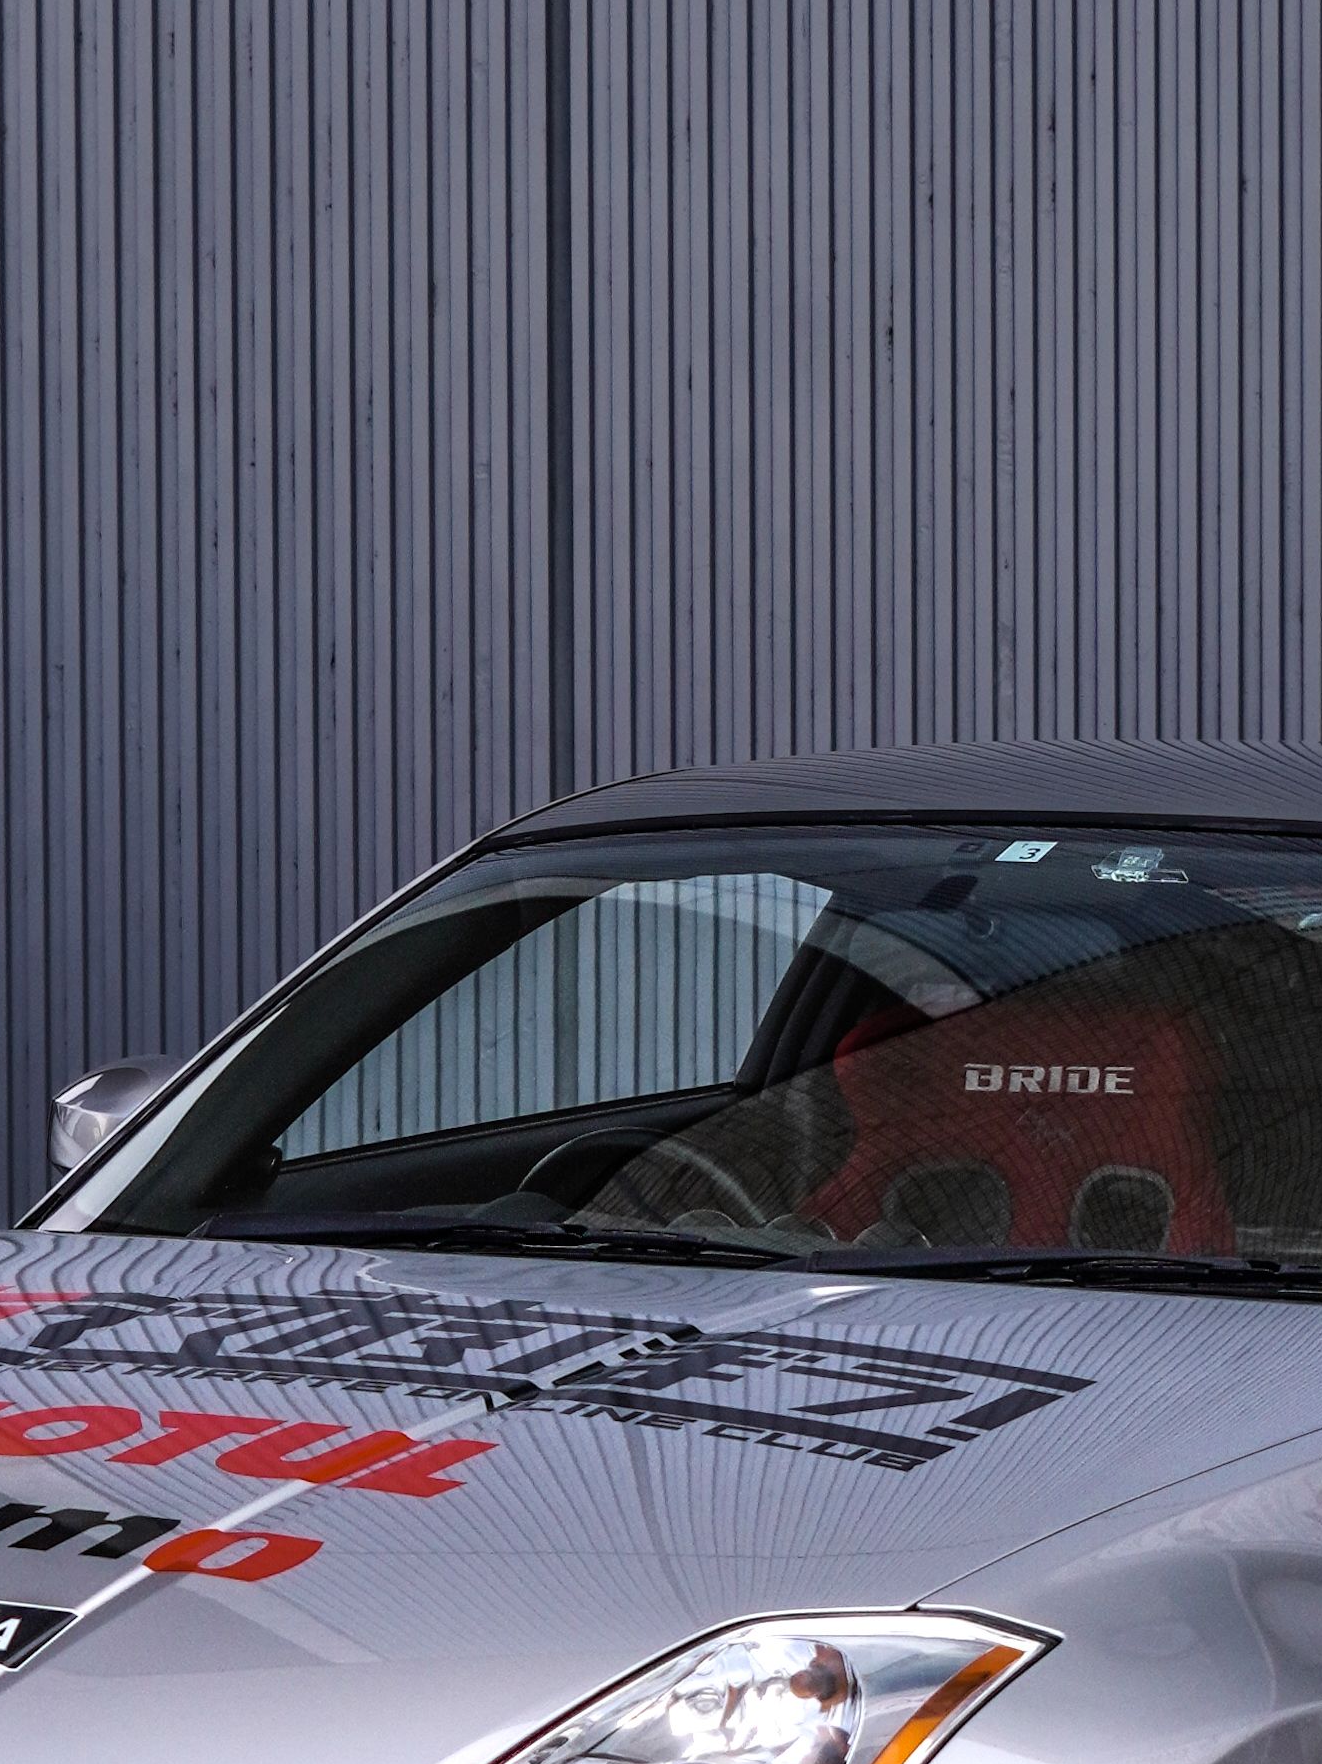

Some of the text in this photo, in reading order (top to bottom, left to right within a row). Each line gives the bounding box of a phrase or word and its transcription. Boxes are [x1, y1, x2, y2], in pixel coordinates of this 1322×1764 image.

[964, 1062, 1135, 1095] BRIDE
[123, 1361, 394, 1394] HIRATE
[703, 1422, 934, 1473] CLUB
